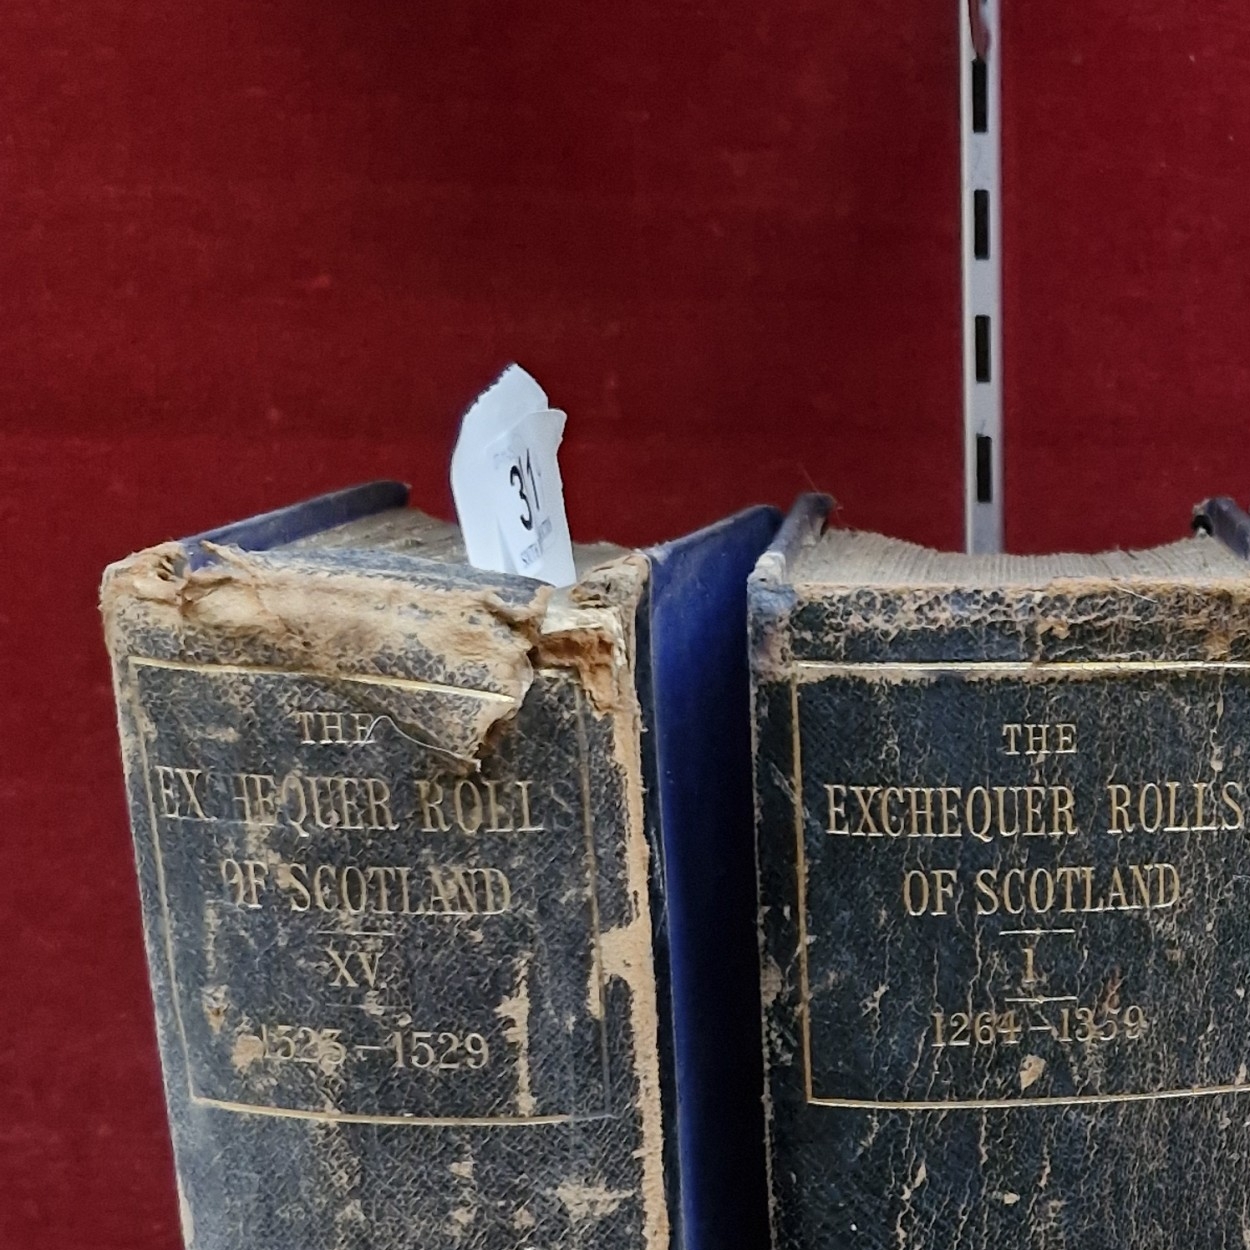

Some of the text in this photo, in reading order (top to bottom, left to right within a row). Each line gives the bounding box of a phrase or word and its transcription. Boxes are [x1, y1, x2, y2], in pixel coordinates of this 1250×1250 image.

[301, 711, 377, 744] THE
[1003, 723, 1078, 755] THE
[154, 765, 399, 837] EXHEQUER
[823, 781, 1245, 843] EXCHEQUER ROLLS
[220, 858, 511, 915] OF SCOTLAND
[903, 862, 1181, 917] OF SCOTLAND
[324, 948, 385, 988] XV
